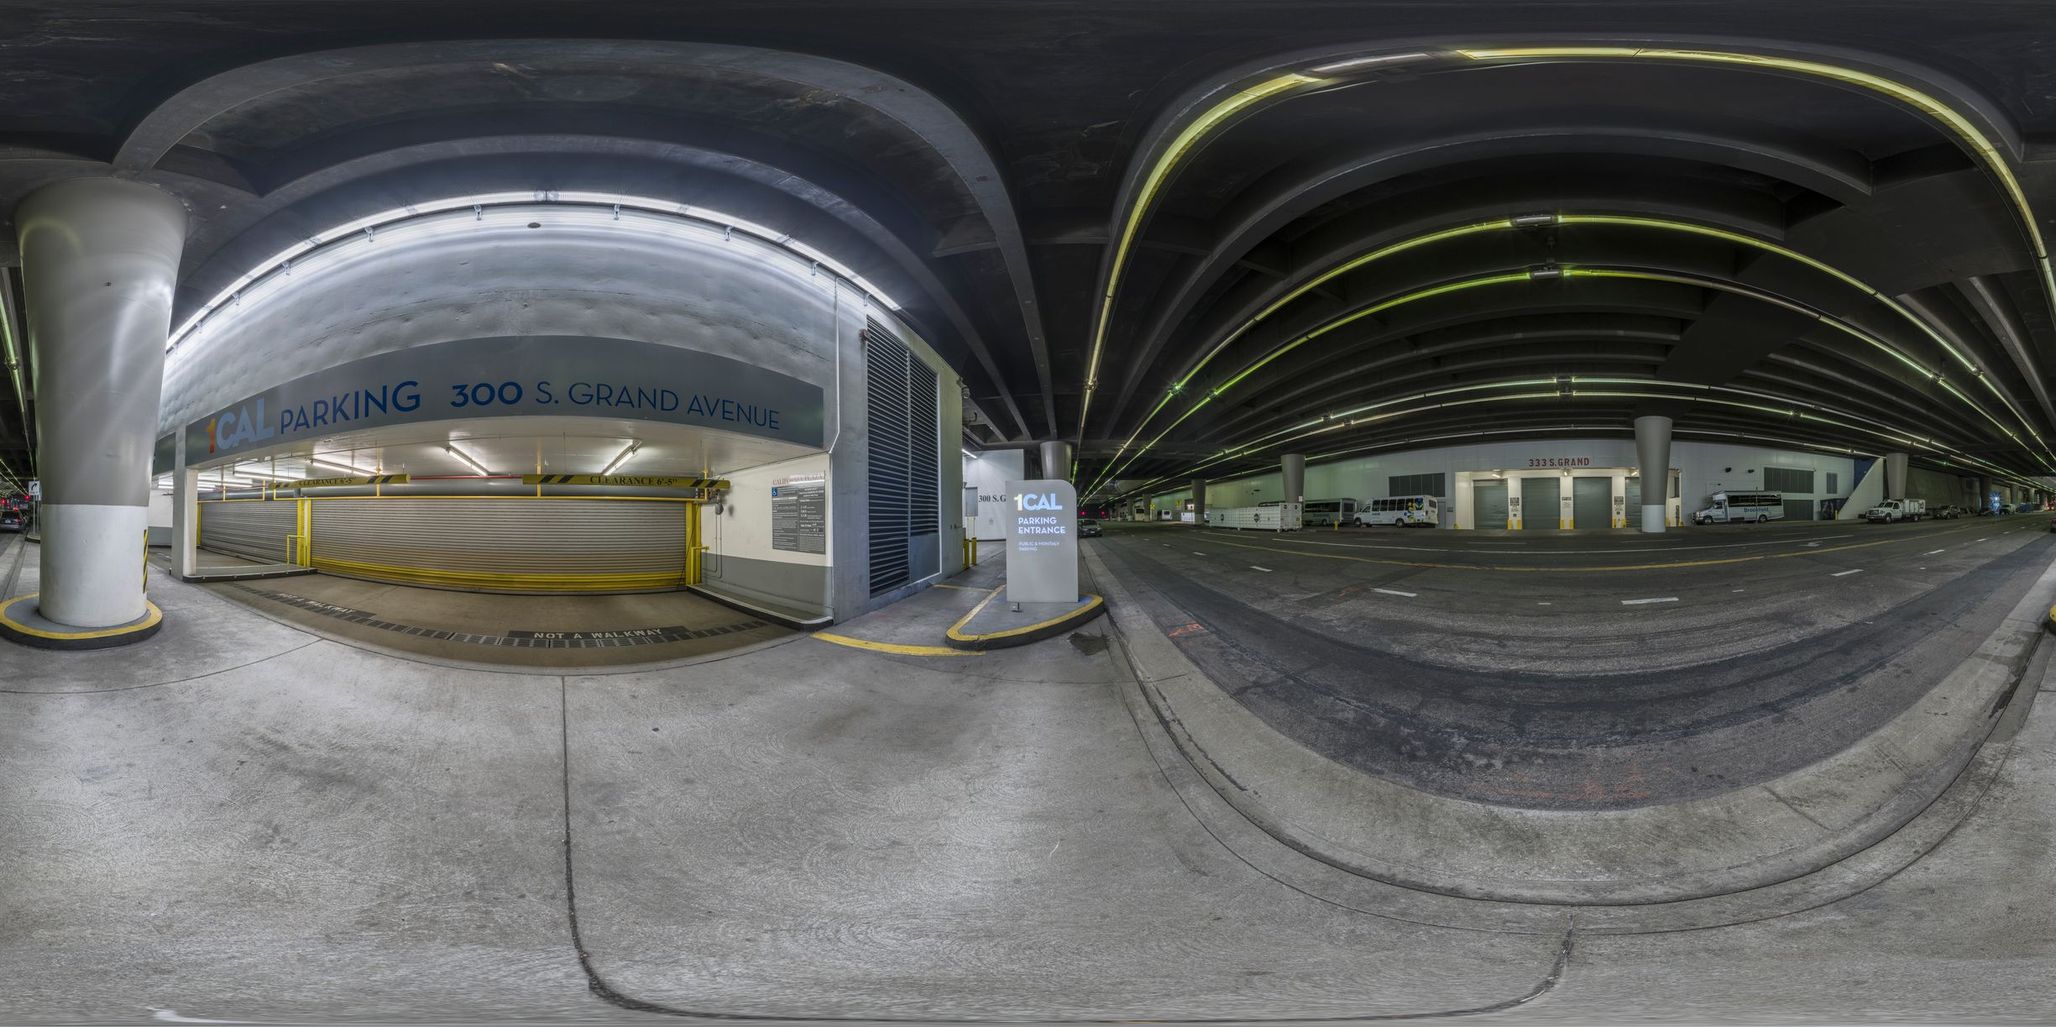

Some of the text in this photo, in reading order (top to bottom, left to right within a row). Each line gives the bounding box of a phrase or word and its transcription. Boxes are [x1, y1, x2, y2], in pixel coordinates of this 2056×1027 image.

[207, 380, 780, 453] 1CAL PARKING 300 S. GRAND AVENUE
[1528, 459, 1547, 467] 333
[590, 476, 654, 486] CLEARANCE
[978, 494, 991, 503] 300
[1014, 493, 1063, 511] 1CAL
[1018, 517, 1057, 525] PARKING
[1018, 526, 1066, 534] ENTRANCE
[591, 628, 662, 639] WALKWAY
